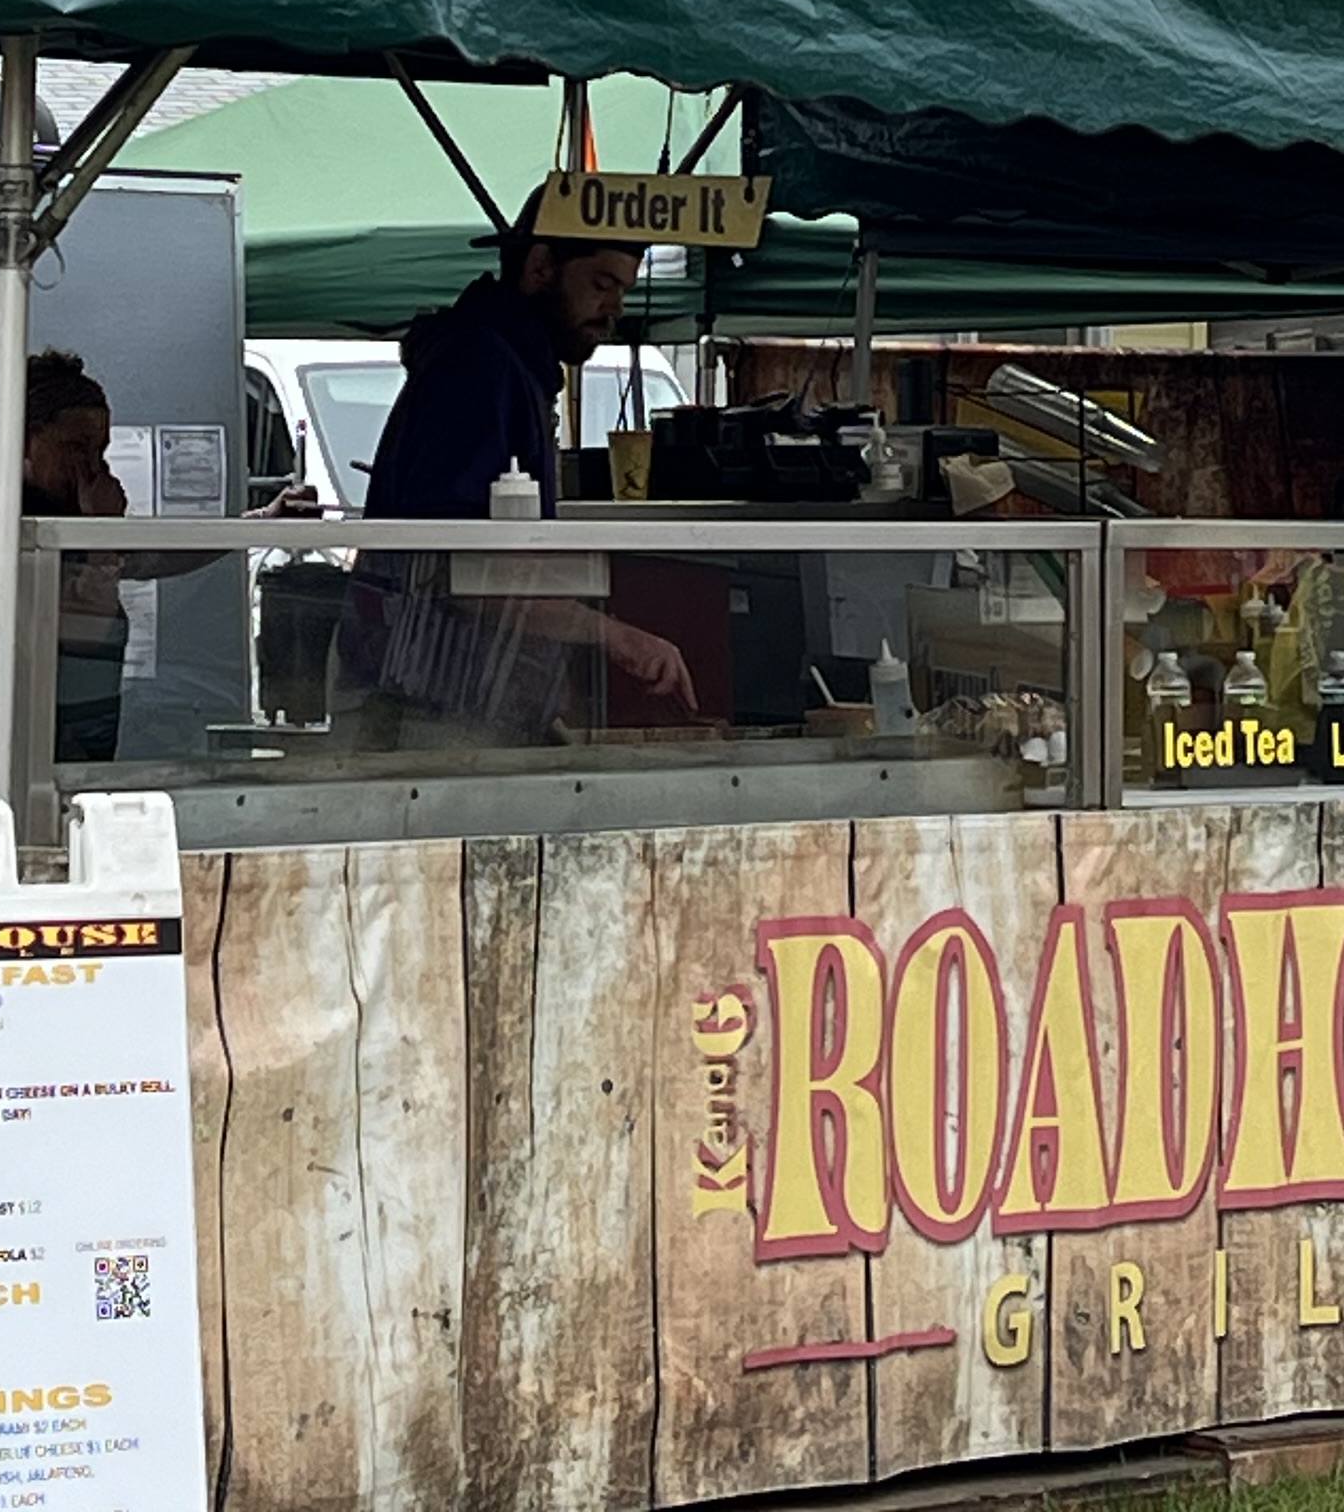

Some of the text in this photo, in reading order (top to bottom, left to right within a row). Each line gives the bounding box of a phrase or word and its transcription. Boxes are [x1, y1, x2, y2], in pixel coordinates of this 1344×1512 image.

[580, 178, 727, 234] Order It
[1164, 719, 1295, 768] Iced Tea
[5, 1085, 56, 1100] CHEESE
